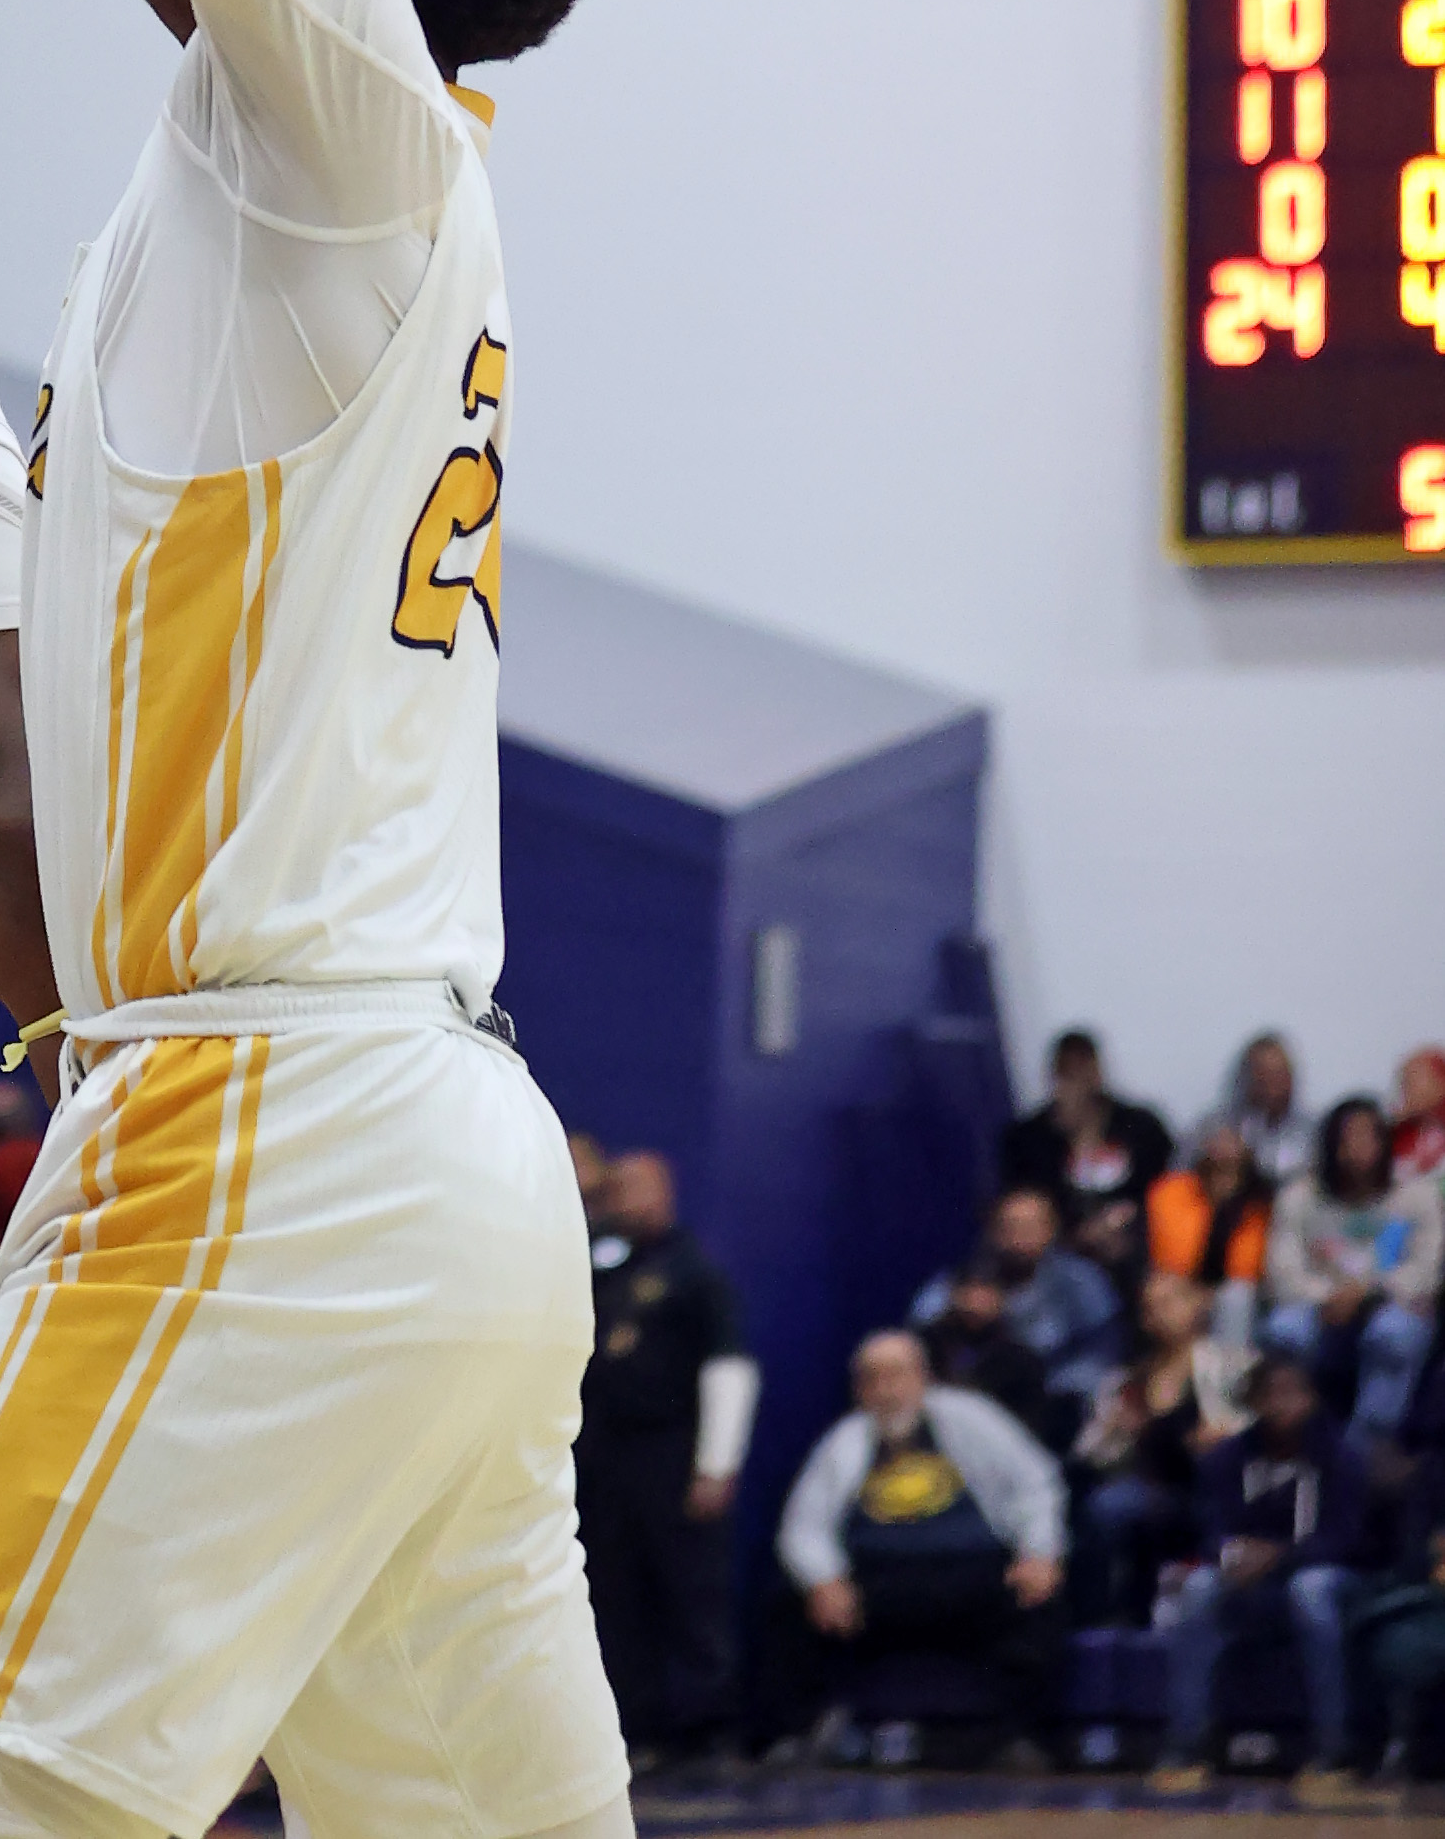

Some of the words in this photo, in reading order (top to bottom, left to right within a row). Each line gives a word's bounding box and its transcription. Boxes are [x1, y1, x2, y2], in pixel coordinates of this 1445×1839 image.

[1239, 67, 1327, 164] 11
[1205, 259, 1326, 366] 24
[391, 438, 503, 659] 2
